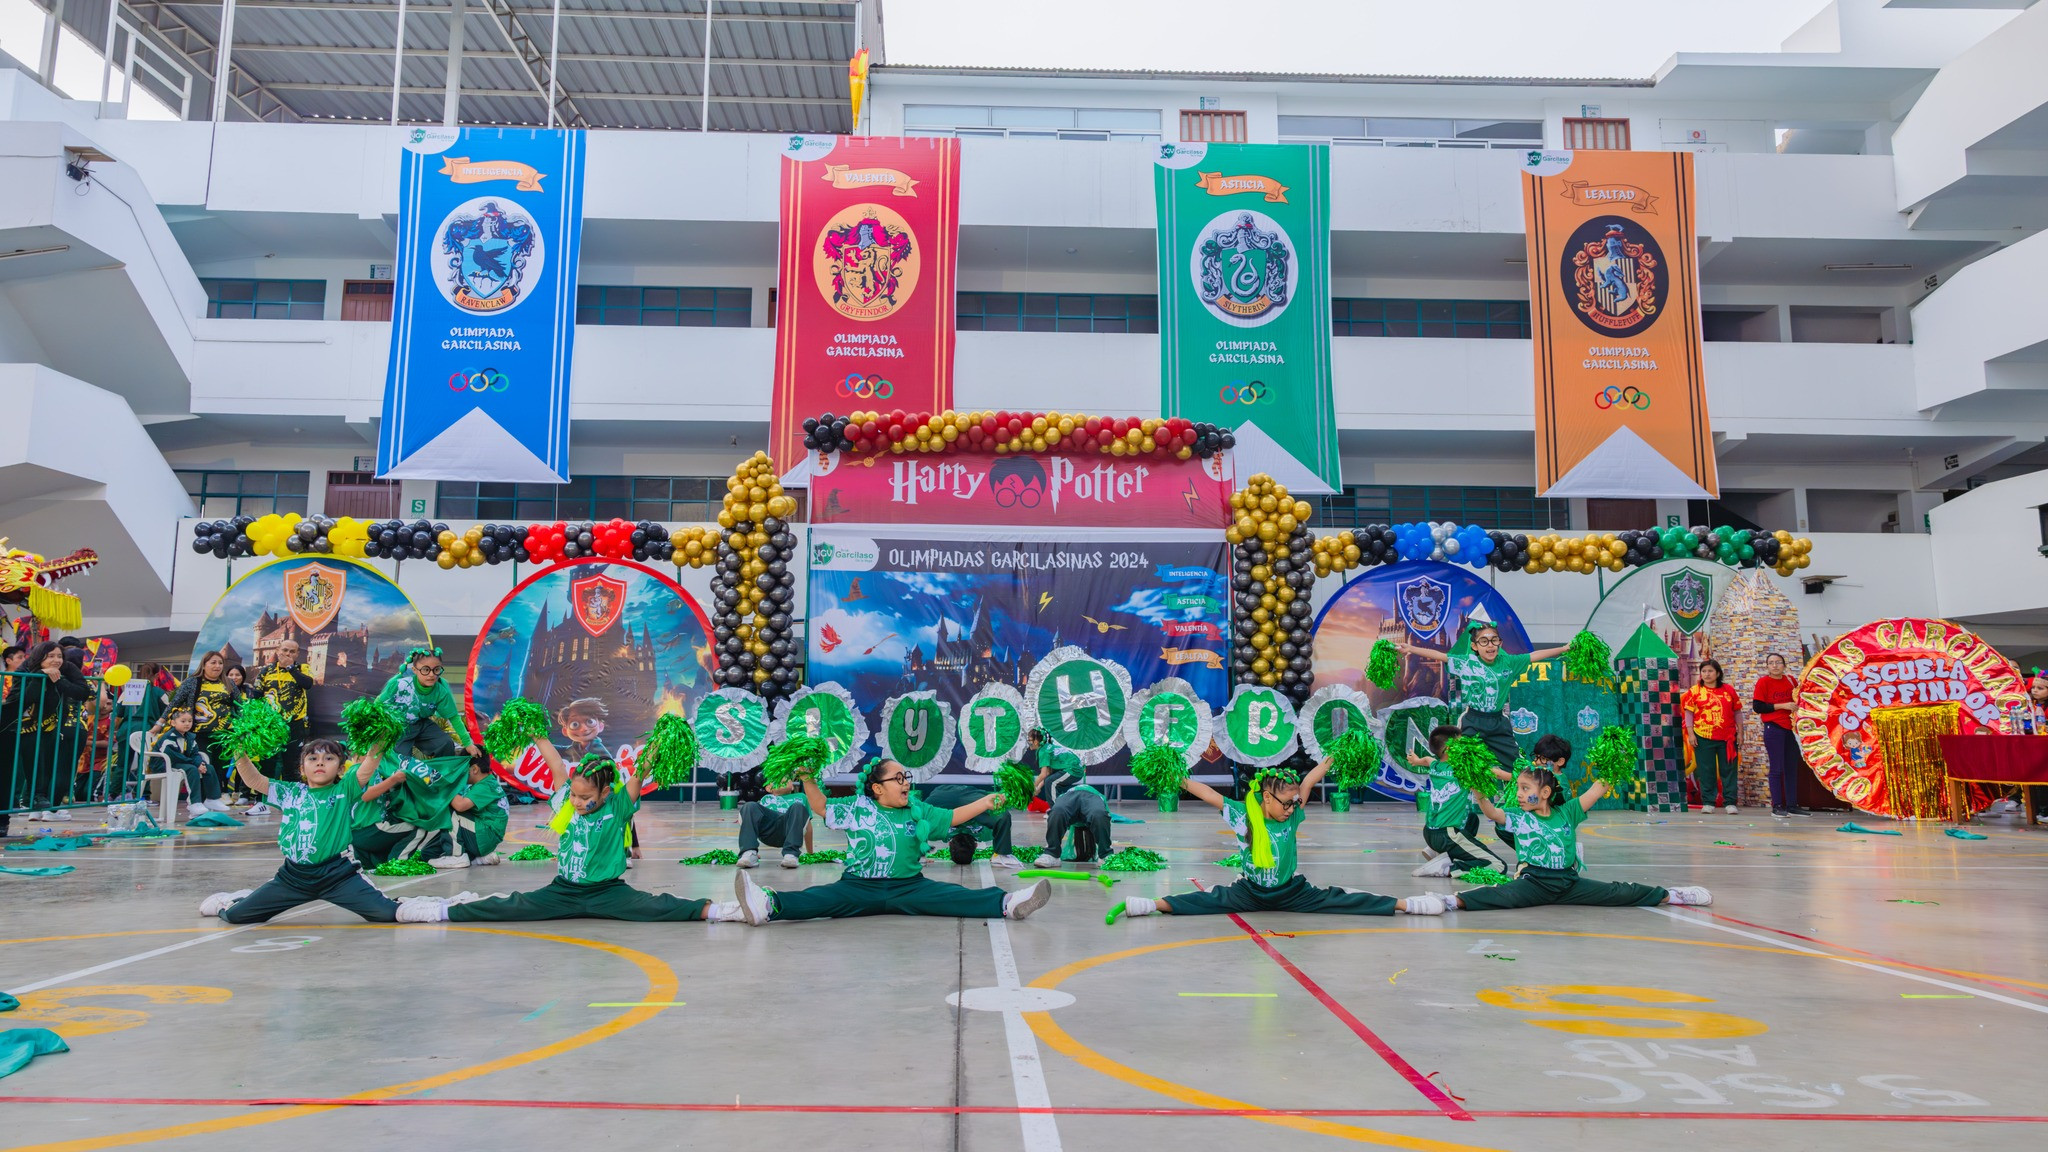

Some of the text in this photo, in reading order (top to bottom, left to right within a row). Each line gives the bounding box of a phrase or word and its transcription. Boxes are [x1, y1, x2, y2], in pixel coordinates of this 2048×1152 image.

[462, 167, 524, 177] INTELIGENCIA
[1220, 179, 1265, 190] ASTUCIA
[1585, 188, 1636, 200] LEALTAD
[460, 296, 507, 309] RAVENCLAW
[1222, 301, 1266, 314] SLYTHERIN
[840, 303, 889, 317] GRYFFINDOR
[1592, 312, 1640, 327] HUFFLEPUFF
[450, 326, 515, 339] OLIMPIADA
[441, 339, 522, 351] GARCILASINA
[833, 333, 898, 345] OLIMPIADA
[1215, 340, 1278, 352] OLIMPIADA
[1588, 346, 1650, 358] OLIMPIADA
[826, 346, 905, 359] GARCILASINA
[1209, 353, 1285, 365] GARCILASINA
[1582, 358, 1658, 371] GARCILASINA
[888, 456, 1150, 515] Harry Potter
[835, 550, 874, 560] Garcilaso
[889, 548, 1149, 573] OLIMPIADAS GARCILASINAS 2024
[1168, 570, 1209, 578] INTELIGENCIA
[1176, 598, 1206, 606] ASTUCIA
[1175, 652, 1209, 661] LEALTAD
[1841, 658, 1968, 694] ESCUELA
[1838, 681, 2001, 730] GRYFFINDOR
